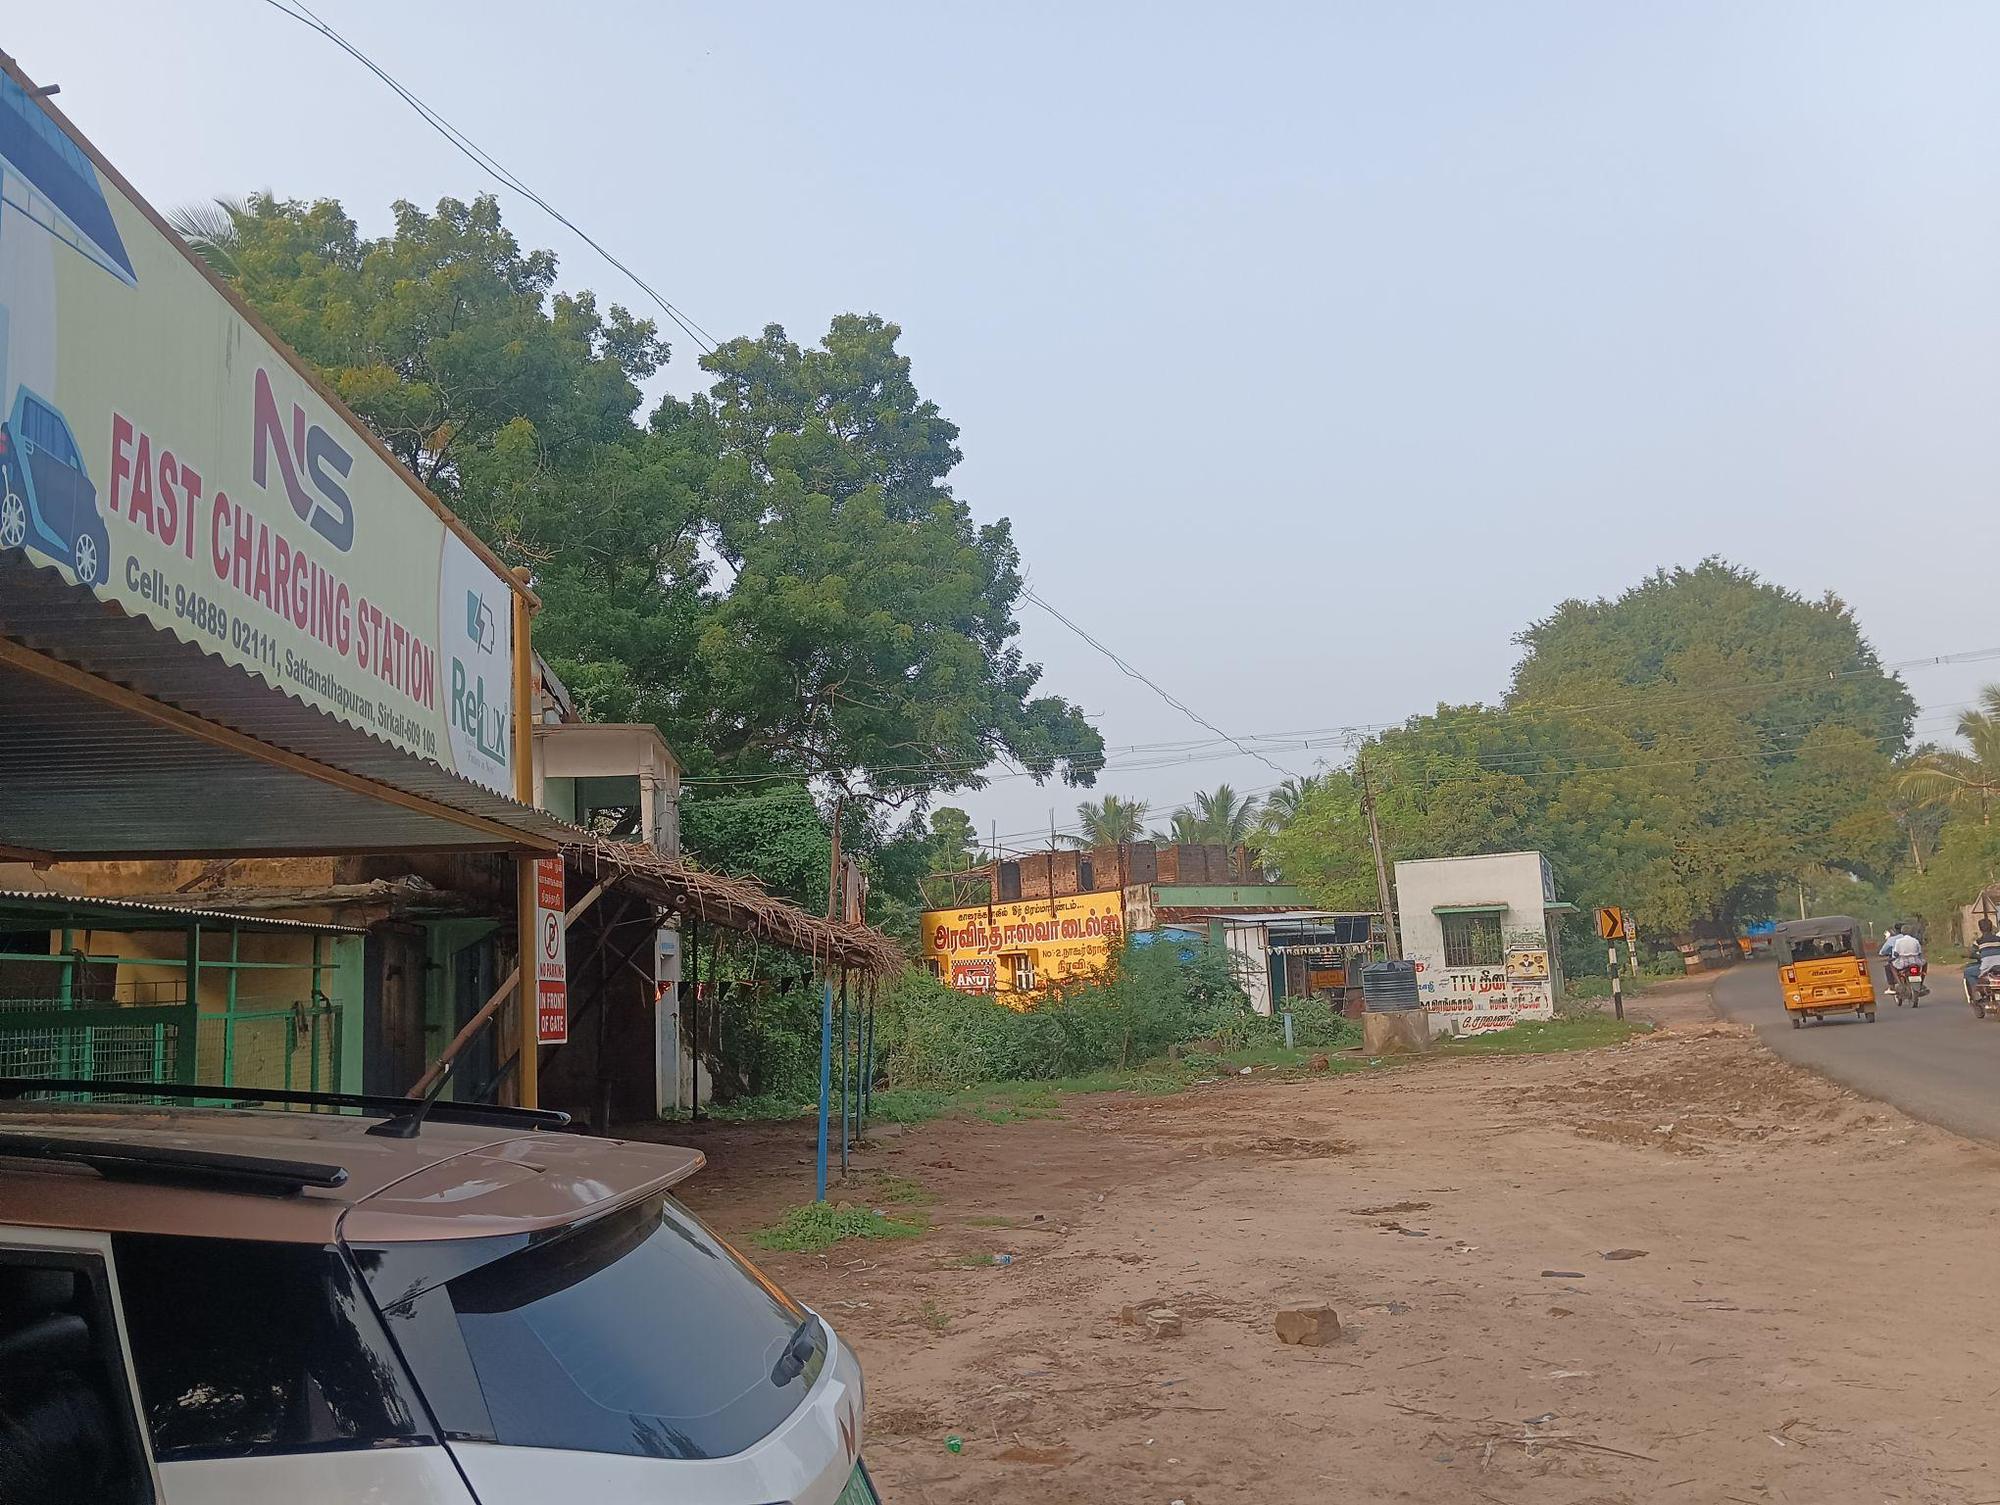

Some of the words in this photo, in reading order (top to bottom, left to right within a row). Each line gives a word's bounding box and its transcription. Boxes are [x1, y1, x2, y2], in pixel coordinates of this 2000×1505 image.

[253, 368, 354, 552] NS
[110, 412, 202, 560] FAST
[212, 491, 351, 656] CHARGING
[357, 598, 434, 711] STATION
[126, 555, 169, 610] Cell:
[175, 583, 228, 641] 94889
[232, 616, 281, 678] 02111,
[285, 648, 376, 728] Sattanathapuram,
[933, 918, 1003, 955] அரவிந்த்
[539, 961, 547, 978] NO
[547, 962, 565, 980] PARKING
[1450, 974, 1476, 992] TTV
[539, 992, 546, 1009] IN
[547, 992, 565, 1009] FRONT
[541, 1015, 549, 1033] OF
[550, 1015, 564, 1032] GATE
